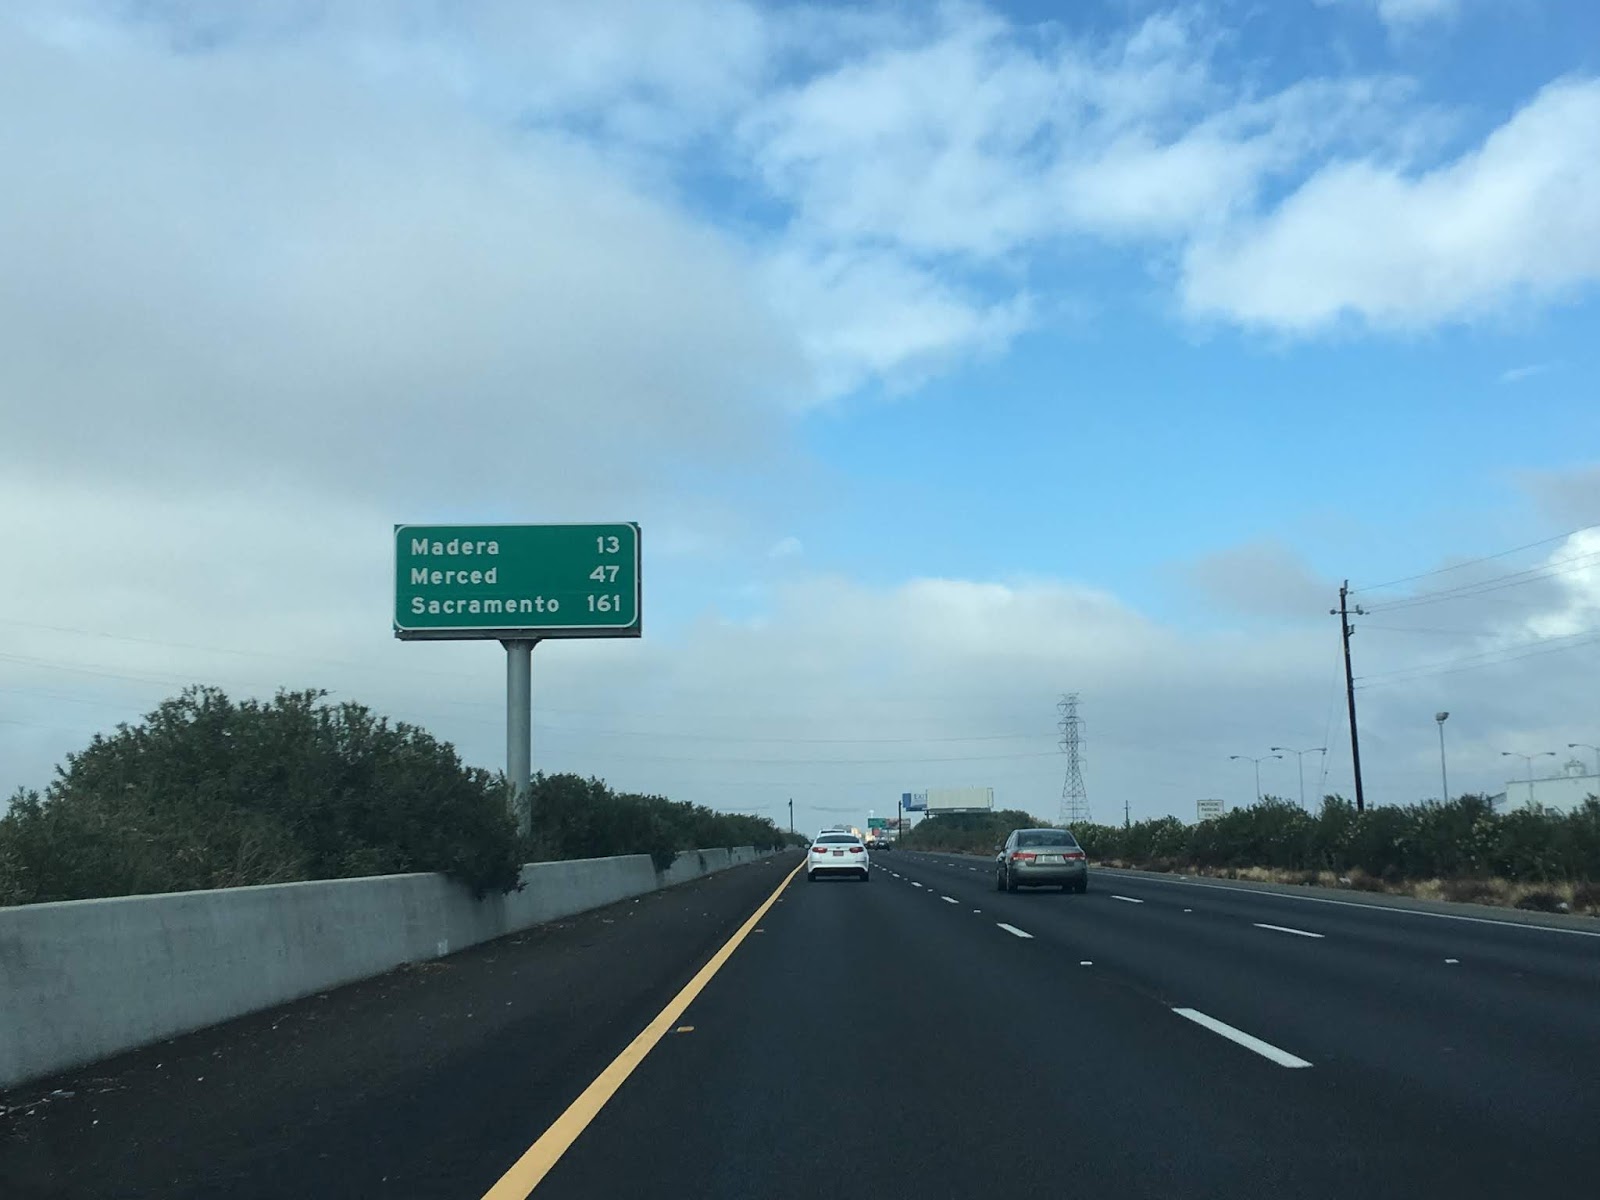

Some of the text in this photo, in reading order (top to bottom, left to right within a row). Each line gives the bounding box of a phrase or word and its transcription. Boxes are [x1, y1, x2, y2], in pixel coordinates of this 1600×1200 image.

[411, 536, 620, 555] Madera 13
[411, 565, 620, 585] Merced 47
[411, 595, 621, 614] Sacramento 161
